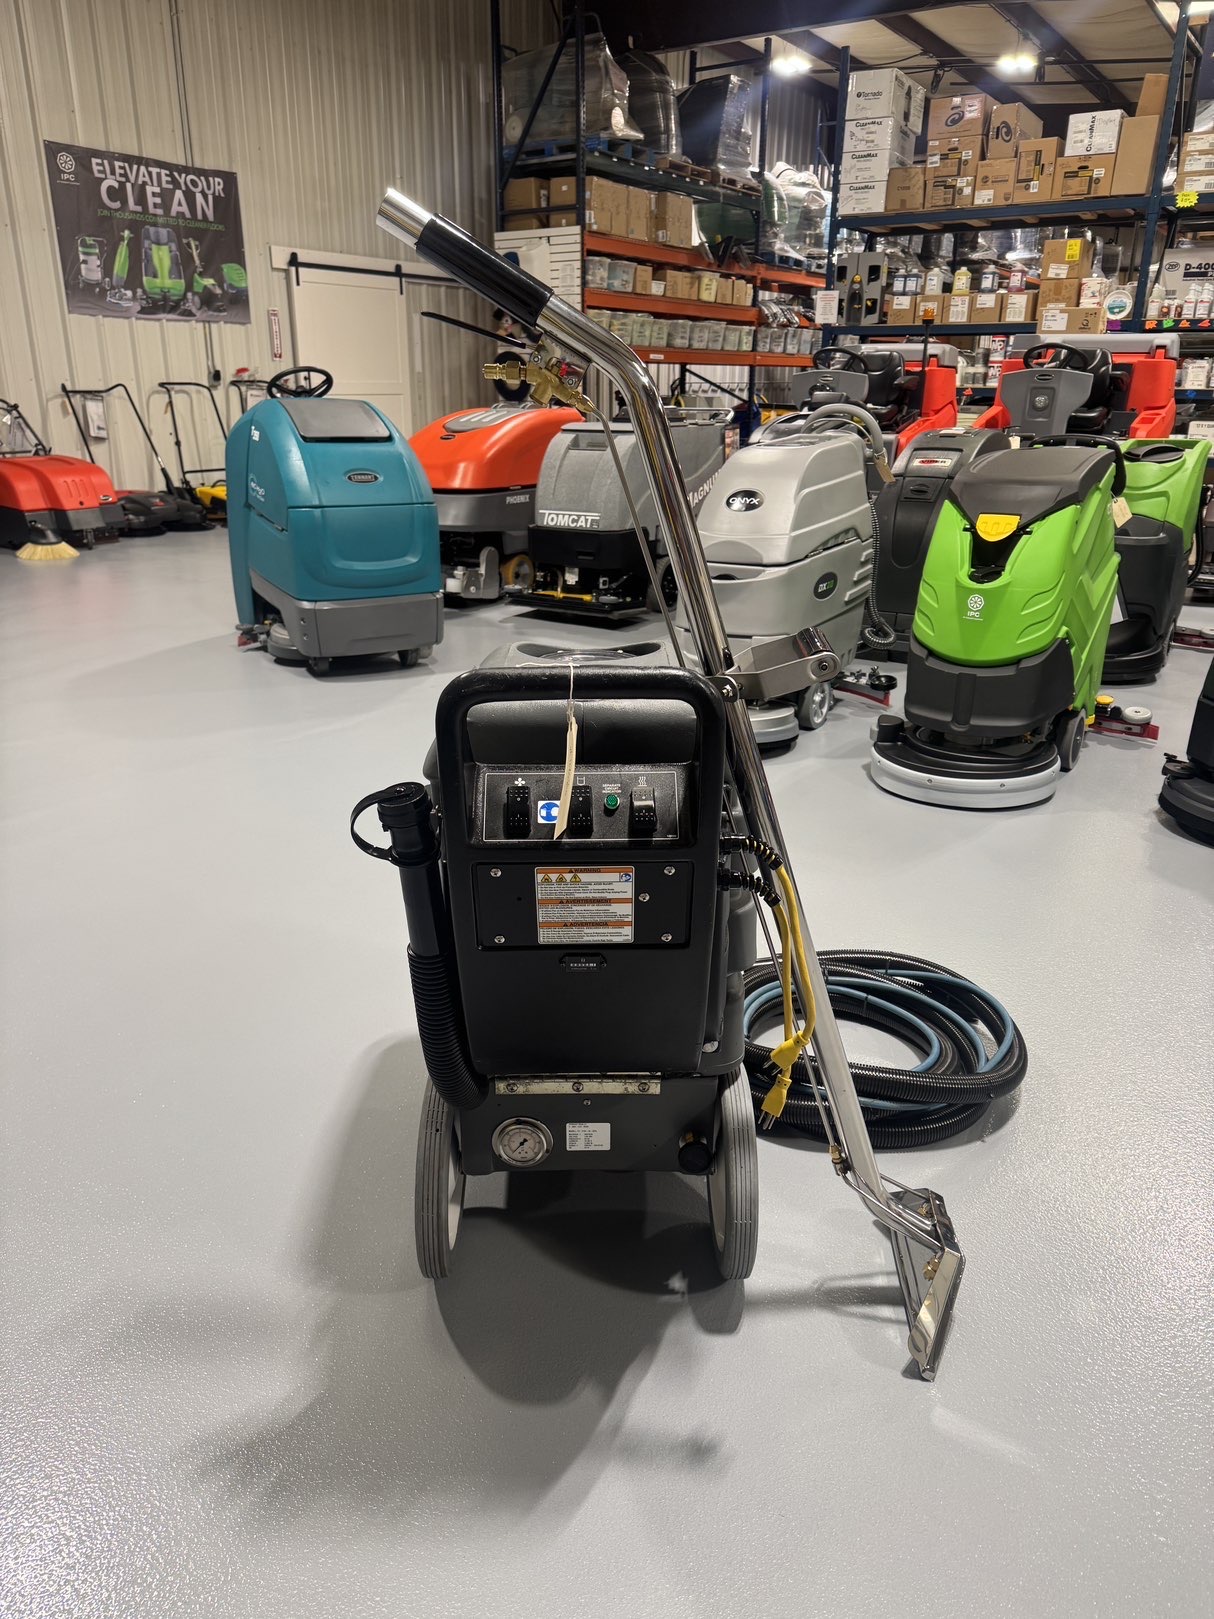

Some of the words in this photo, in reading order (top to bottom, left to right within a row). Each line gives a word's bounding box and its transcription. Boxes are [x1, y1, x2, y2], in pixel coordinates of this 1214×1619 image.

[60, 173, 75, 182] IPC
[91, 157, 173, 190] ELEVATE
[173, 171, 226, 197] YOUR
[100, 180, 214, 222] CLEAN
[506, 494, 530, 505] PHOENIX
[729, 497, 760, 505] ONYX
[539, 510, 601, 528] TOMCAT
